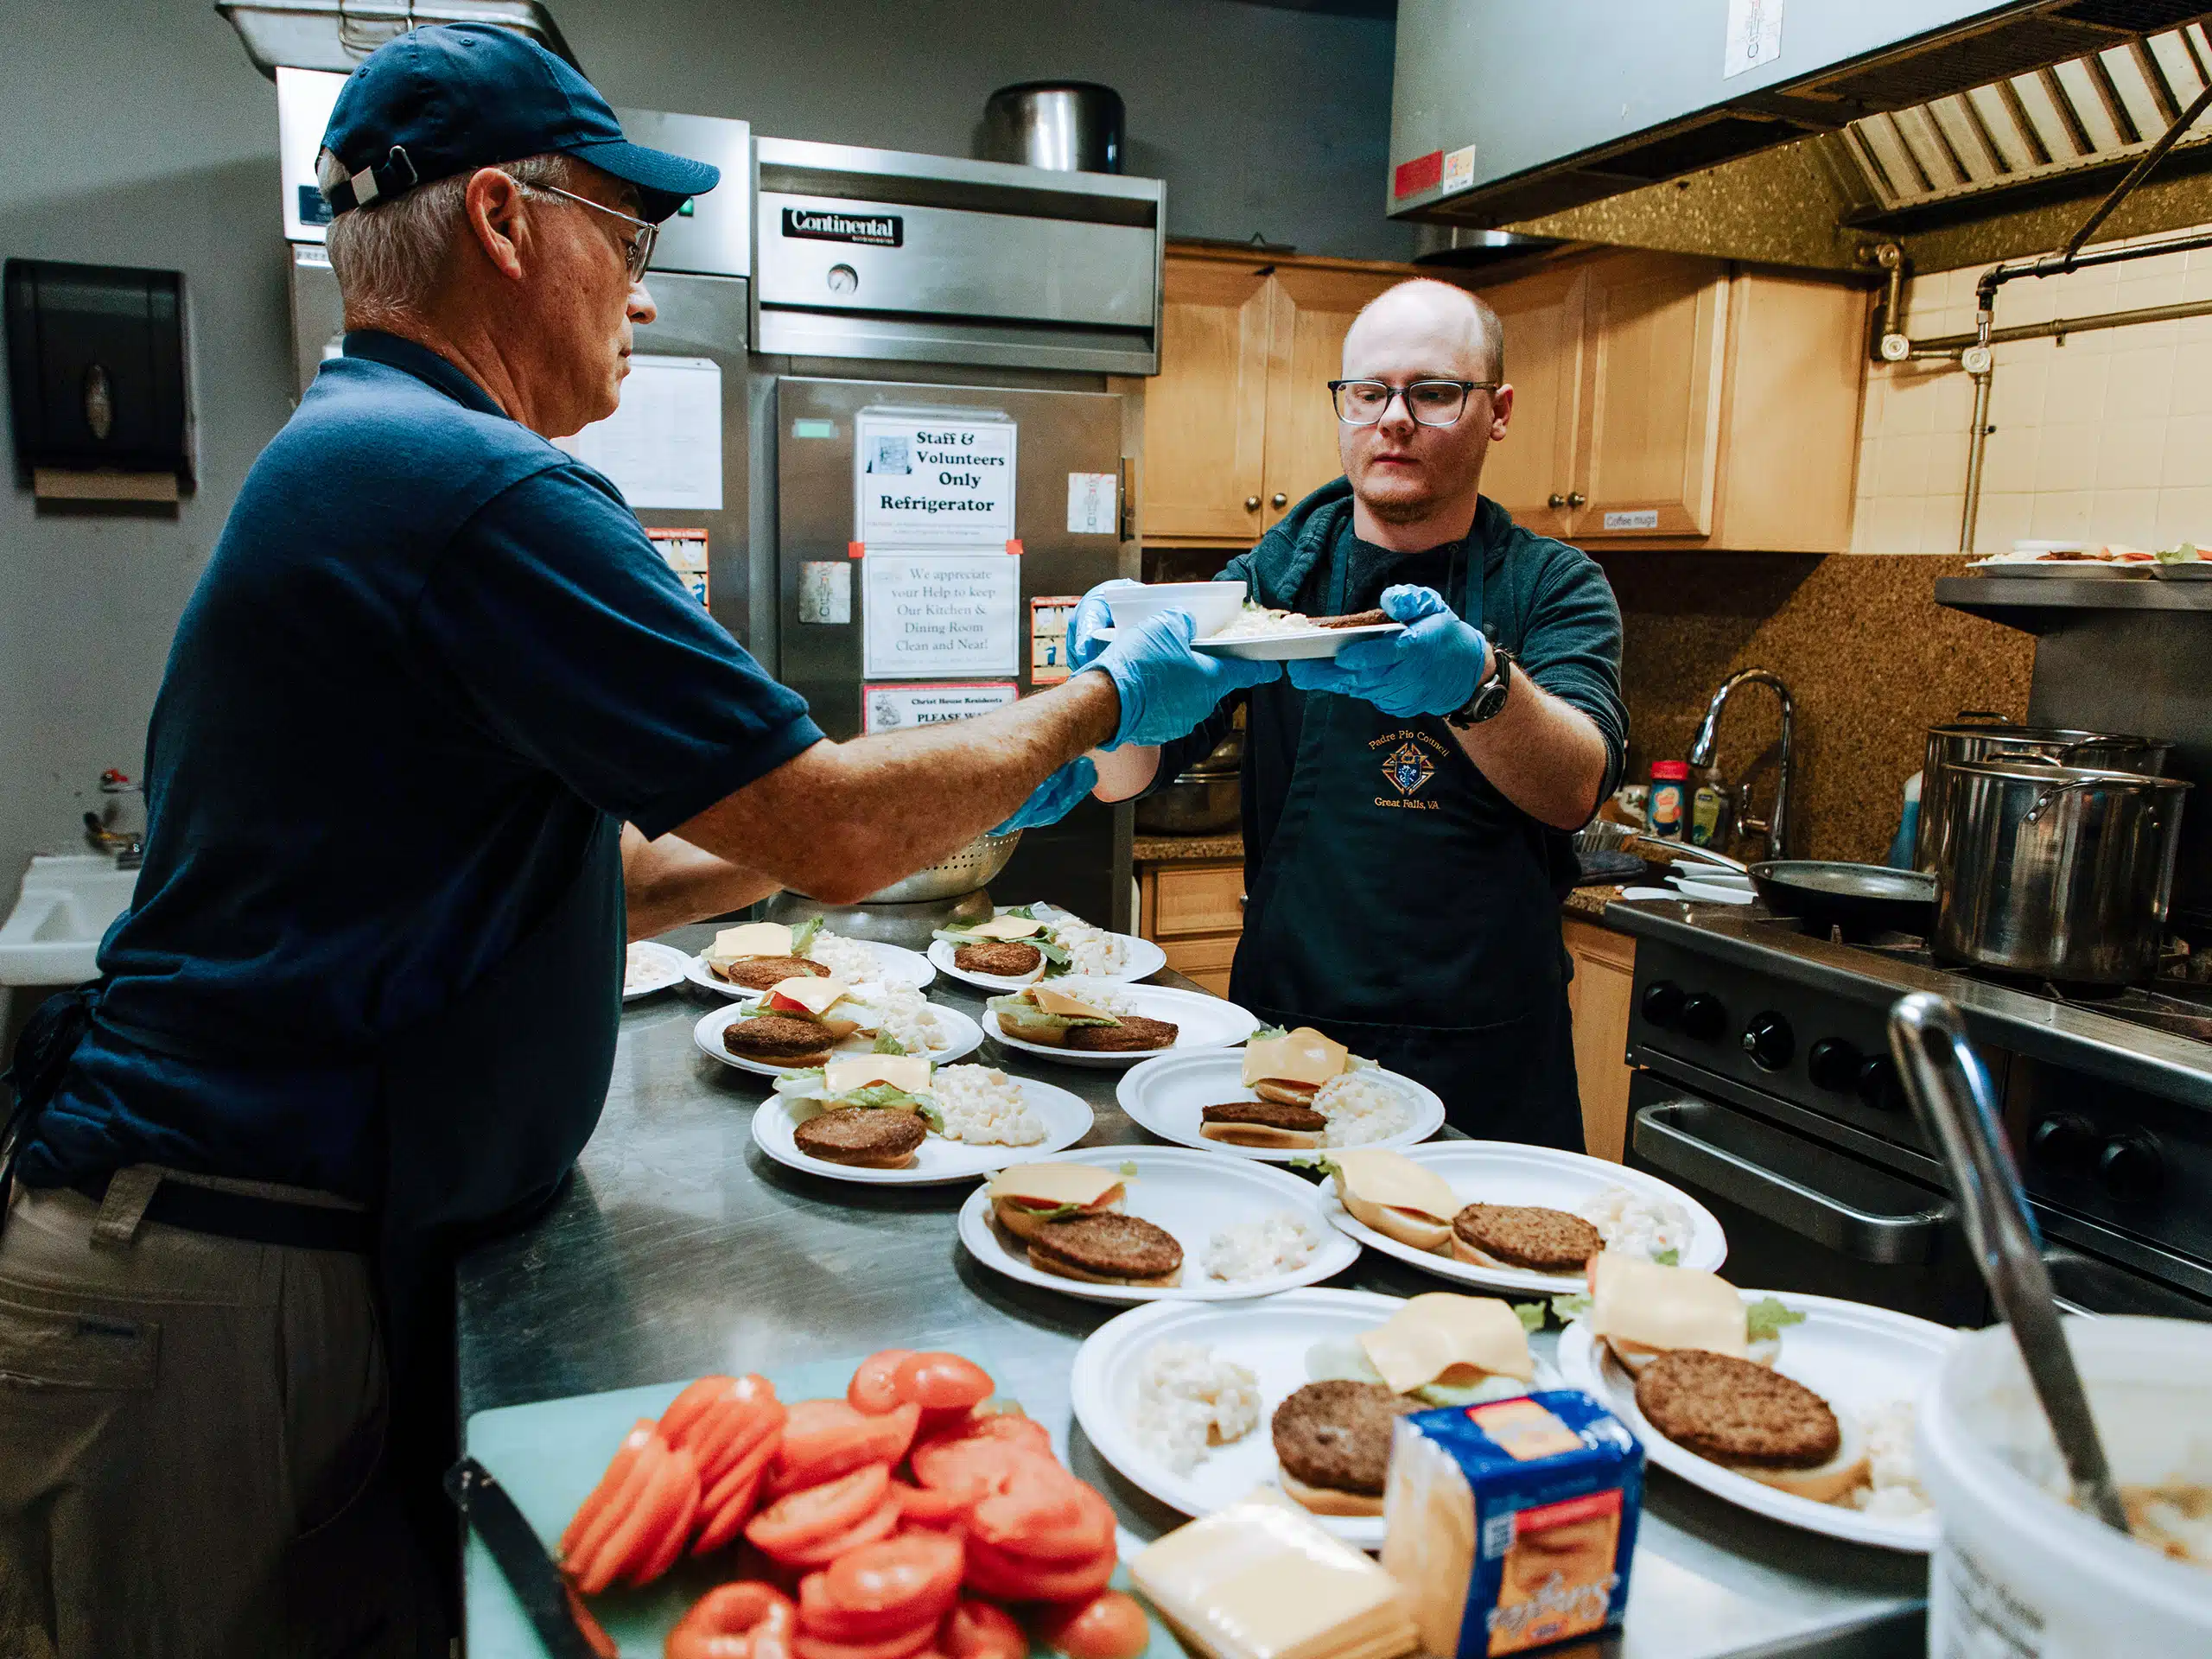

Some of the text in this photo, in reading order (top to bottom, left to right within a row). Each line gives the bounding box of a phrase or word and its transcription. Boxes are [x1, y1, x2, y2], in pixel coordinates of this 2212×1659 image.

[791, 209, 893, 237] Continental
[917, 431, 975, 446] Staff &
[917, 451, 1005, 466] Volunteers
[939, 472, 982, 488] Only
[880, 495, 995, 514] Refrigerator
[910, 568, 992, 582] We appreciate
[892, 586, 996, 600] your Help to keep
[897, 603, 987, 616] Our Kitchen &
[905, 621, 983, 635] Dining Room
[895, 639, 988, 652] Clean and Neat!
[918, 712, 961, 722] PLEASE
[1368, 729, 1450, 758] Padre Pio Council
[1374, 797, 1440, 810] Great Falls, VA
